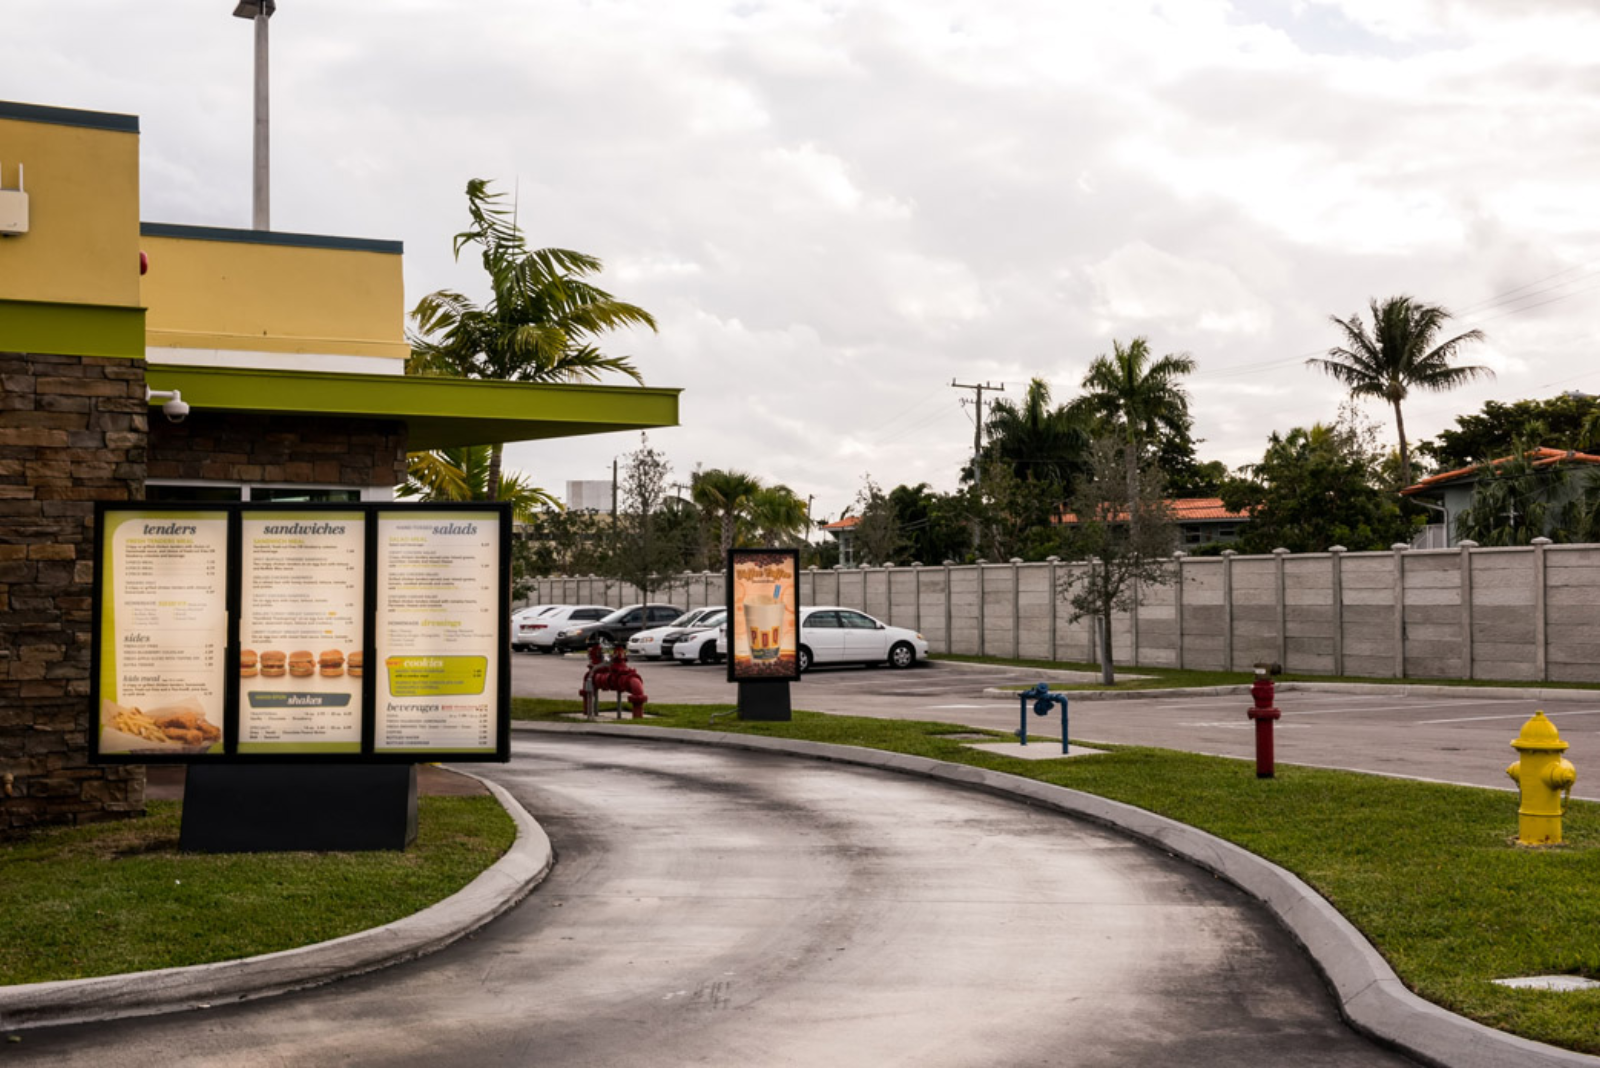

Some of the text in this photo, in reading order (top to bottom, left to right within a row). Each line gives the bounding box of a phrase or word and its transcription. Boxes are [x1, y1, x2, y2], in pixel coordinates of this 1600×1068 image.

[143, 522, 197, 535] tenders
[263, 522, 346, 535] sandwiches
[432, 522, 478, 535] salads
[123, 633, 150, 642] sides
[404, 657, 443, 668] cookies
[123, 674, 140, 682] kids
[140, 674, 160, 682] meal
[286, 694, 323, 705] shakes
[386, 702, 440, 714] beverages
